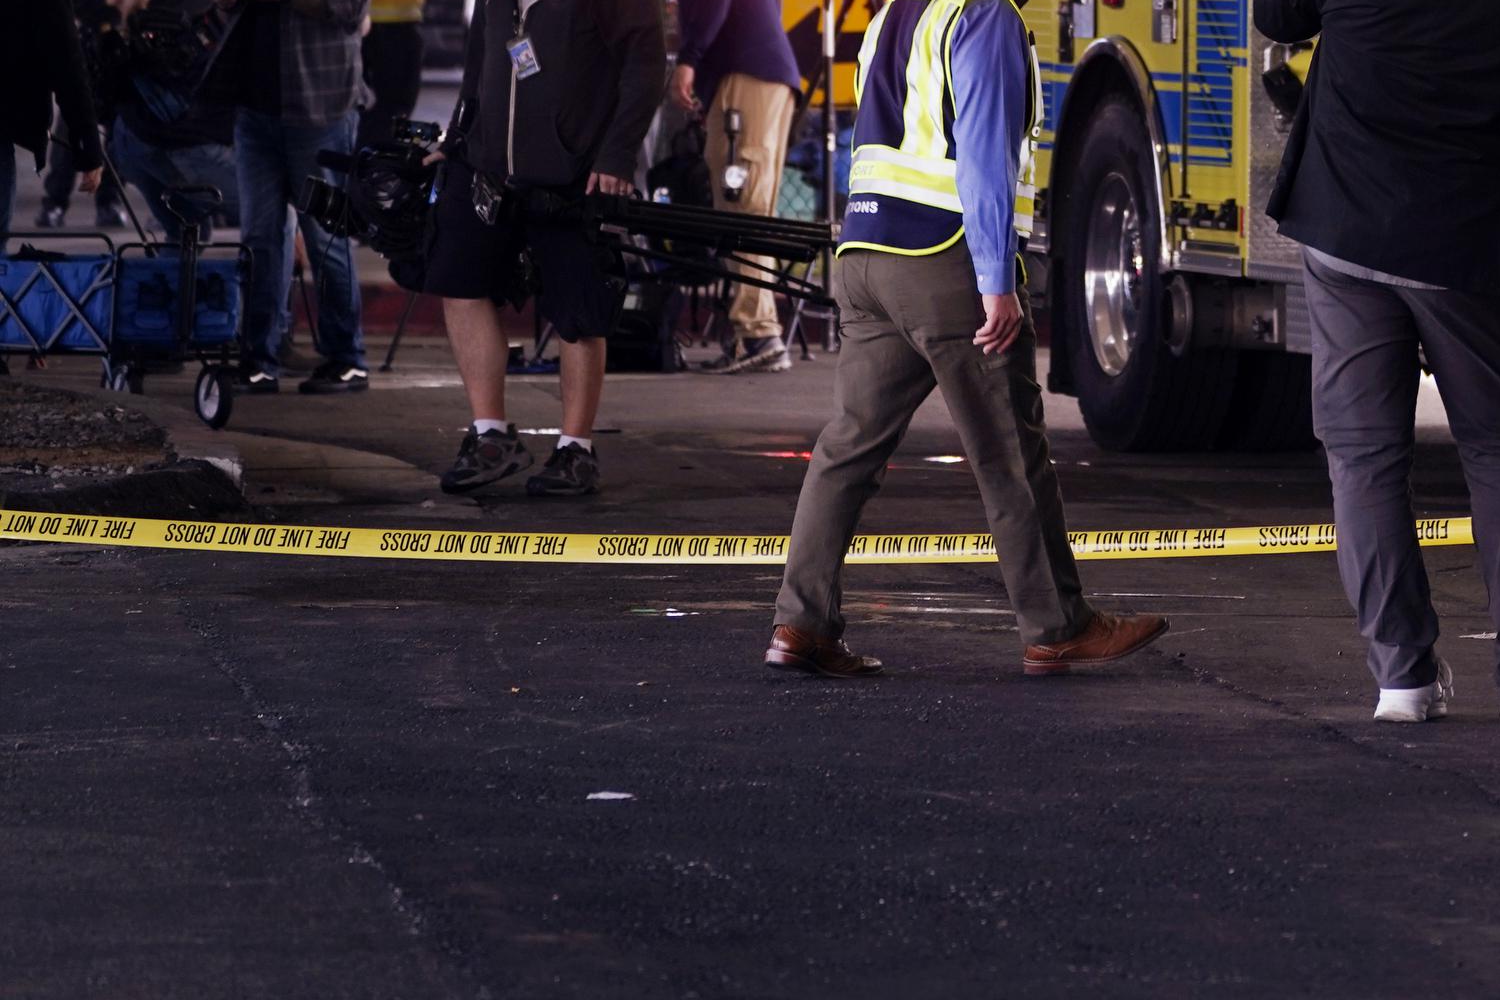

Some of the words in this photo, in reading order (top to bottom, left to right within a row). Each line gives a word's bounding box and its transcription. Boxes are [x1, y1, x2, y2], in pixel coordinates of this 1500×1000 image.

[3, 514, 37, 533] NOT
[39, 516, 61, 535] DO
[65, 517, 97, 539] LINE
[100, 519, 136, 540] FIRE
[164, 523, 218, 544] CROSS
[218, 525, 251, 546] NOT
[254, 527, 277, 547] DO
[279, 529, 313, 549] LINE
[315, 530, 351, 550] FIRE
[380, 531, 432, 552] CROSS
[434, 533, 467, 553] NOT
[470, 534, 493, 554] DO
[495, 535, 530, 555] LINE
[971, 535, 997, 555] IRE
[1092, 532, 1123, 552] NOT
[1129, 532, 1150, 551] DO
[1154, 530, 1188, 550] LINE
[1193, 529, 1226, 549] FIRE
[1259, 526, 1310, 547] CROSS
[1315, 525, 1335, 545] OT
[533, 536, 570, 555] FIRE
[597, 536, 650, 556] CROSS
[652, 537, 685, 556] NOT
[687, 537, 711, 557] DO
[713, 537, 748, 557] LINE
[751, 537, 786, 556] FIRE
[908, 537, 929, 555] DO
[934, 536, 967, 555] LINE
